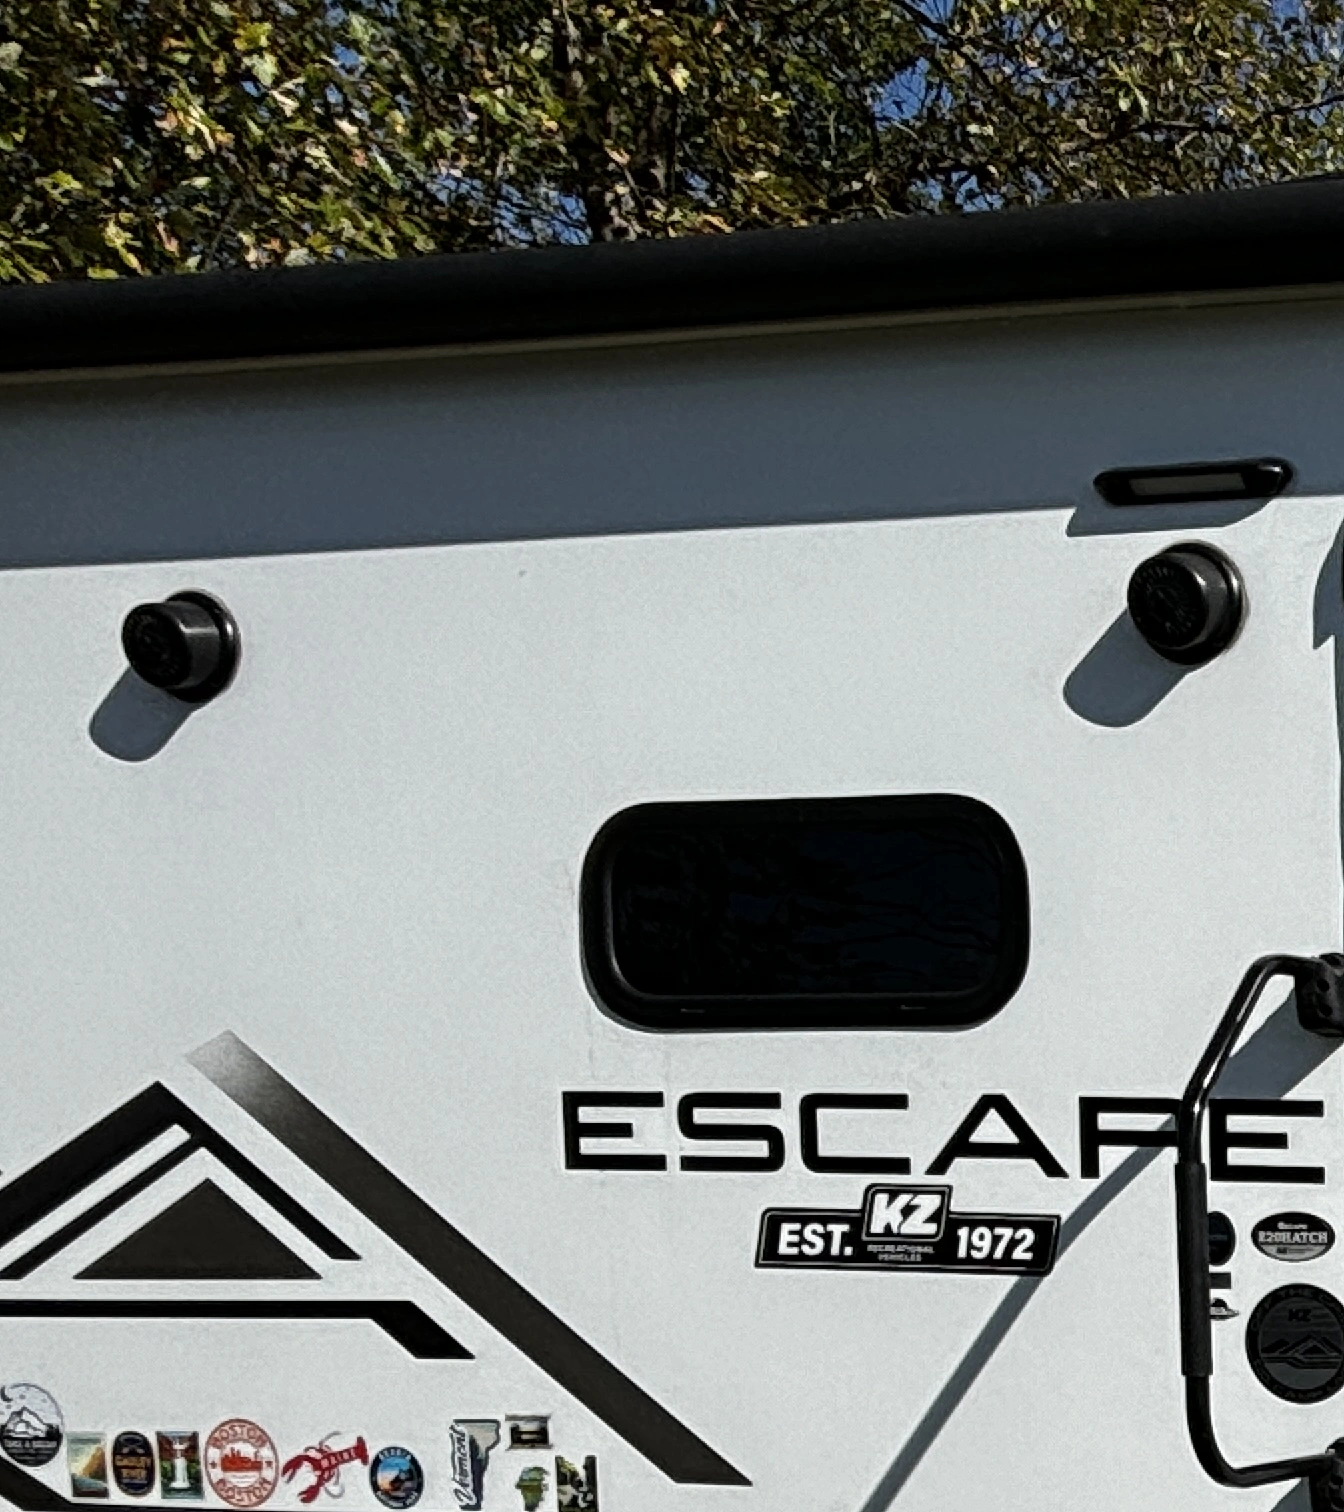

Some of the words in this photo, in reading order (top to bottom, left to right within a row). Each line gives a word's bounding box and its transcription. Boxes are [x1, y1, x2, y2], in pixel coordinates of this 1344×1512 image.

[562, 1091, 1324, 1183] ESCAPE
[870, 1192, 942, 1235] KZ
[777, 1222, 853, 1256] EST.
[957, 1226, 1035, 1260] 1972
[210, 1424, 270, 1449] BOSTON
[450, 1424, 476, 1505] Vermont
[214, 1477, 272, 1502] BOSTON
